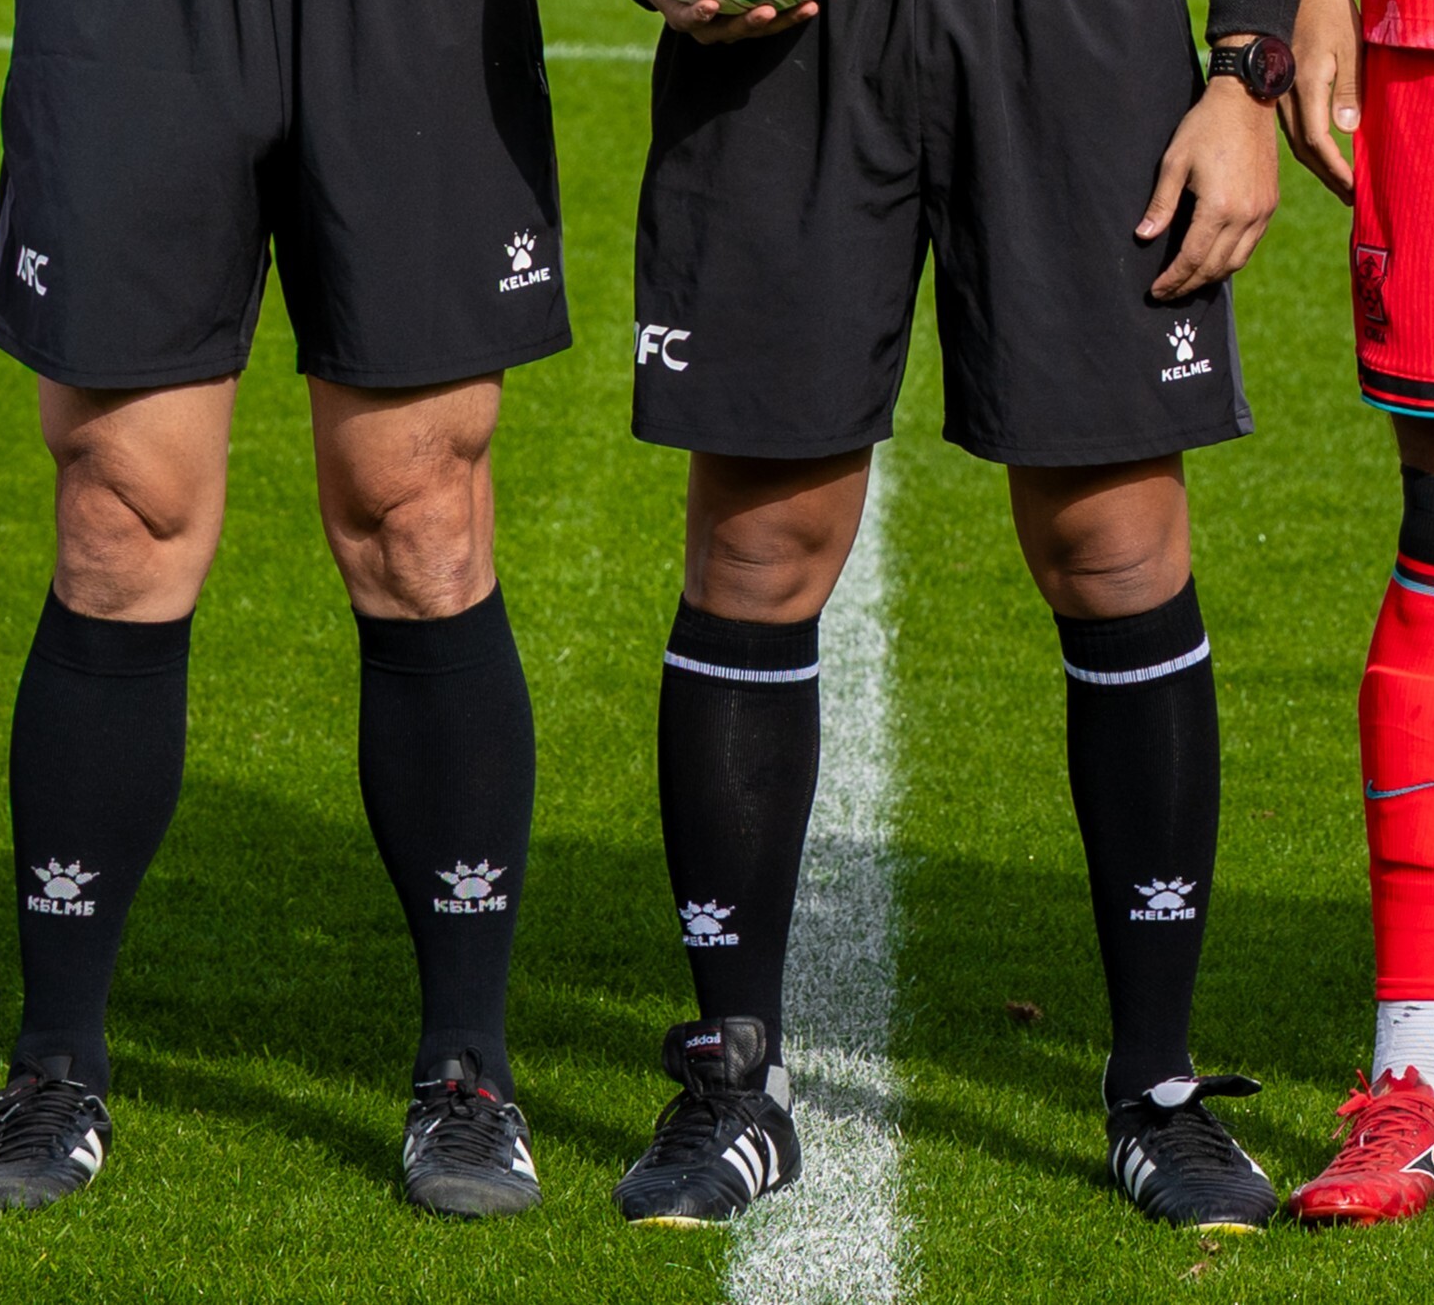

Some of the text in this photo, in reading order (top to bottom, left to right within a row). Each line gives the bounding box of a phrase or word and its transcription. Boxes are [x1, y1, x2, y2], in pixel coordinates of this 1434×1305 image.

[499, 268, 550, 292] KELME
[634, 322, 691, 371] FC
[1162, 358, 1212, 382] KELME
[27, 894, 96, 916] KELME
[434, 894, 507, 914] KELME
[1130, 908, 1196, 922] KELME
